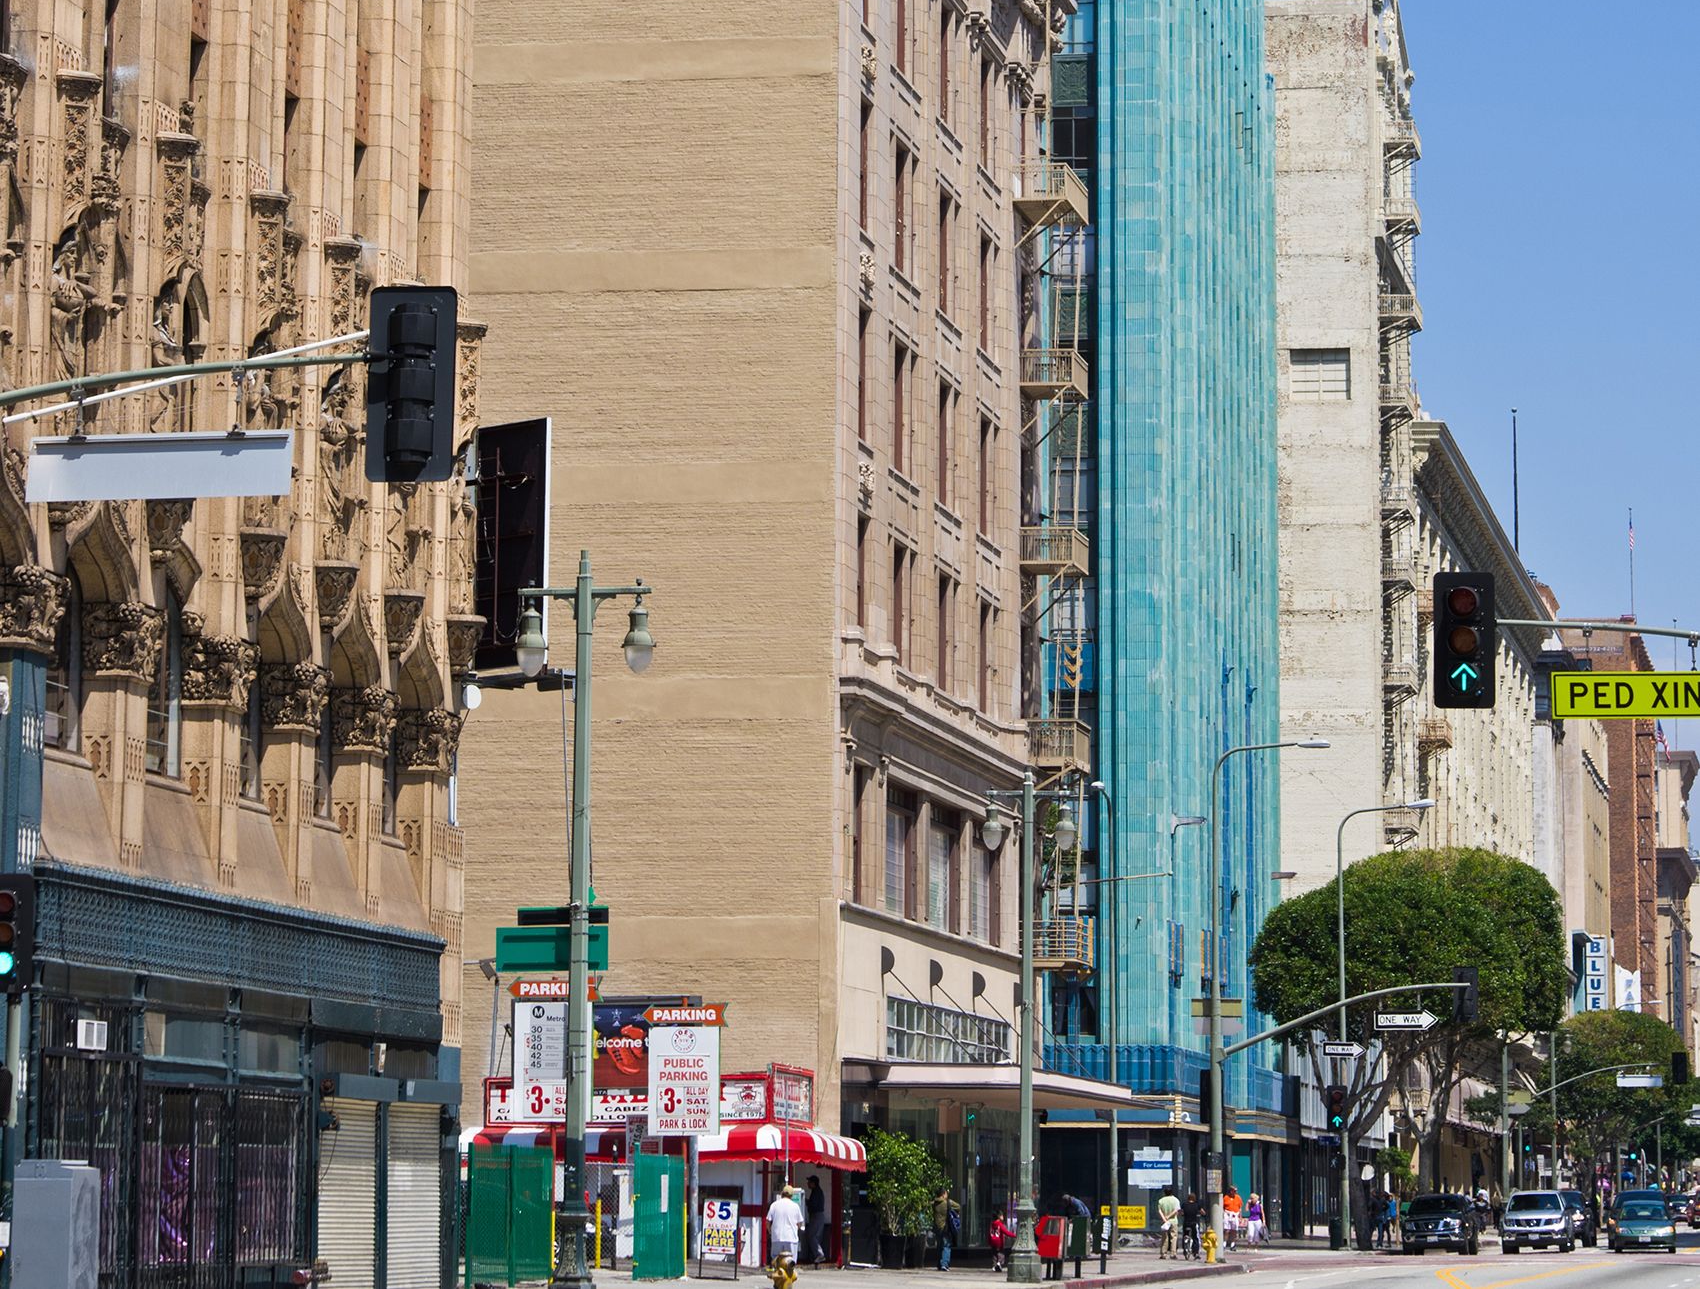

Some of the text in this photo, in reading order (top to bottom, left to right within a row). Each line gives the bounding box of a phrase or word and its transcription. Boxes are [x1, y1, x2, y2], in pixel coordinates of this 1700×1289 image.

[1569, 681, 1634, 709] PED
[1590, 941, 1601, 1009] BLUE
[519, 982, 589, 997] PARKI
[652, 1008, 717, 1021] PARKING
[1379, 1015, 1422, 1025] ONE WAY
[530, 1025, 543, 1034] 30
[530, 1034, 543, 1043] 35
[595, 1037, 643, 1048] elcome
[530, 1043, 543, 1051] 40
[530, 1052, 542, 1060] 42
[530, 1061, 542, 1069] 45
[663, 1058, 704, 1069] PUBLIC
[659, 1071, 708, 1081] PARKING
[685, 1087, 708, 1096] ALL DAY
[659, 1118, 679, 1129] PARK
[681, 1118, 687, 1129] &
[689, 1118, 708, 1129] LOCK
[705, 1228, 735, 1238] PARK
[705, 1238, 735, 1247] HERE
